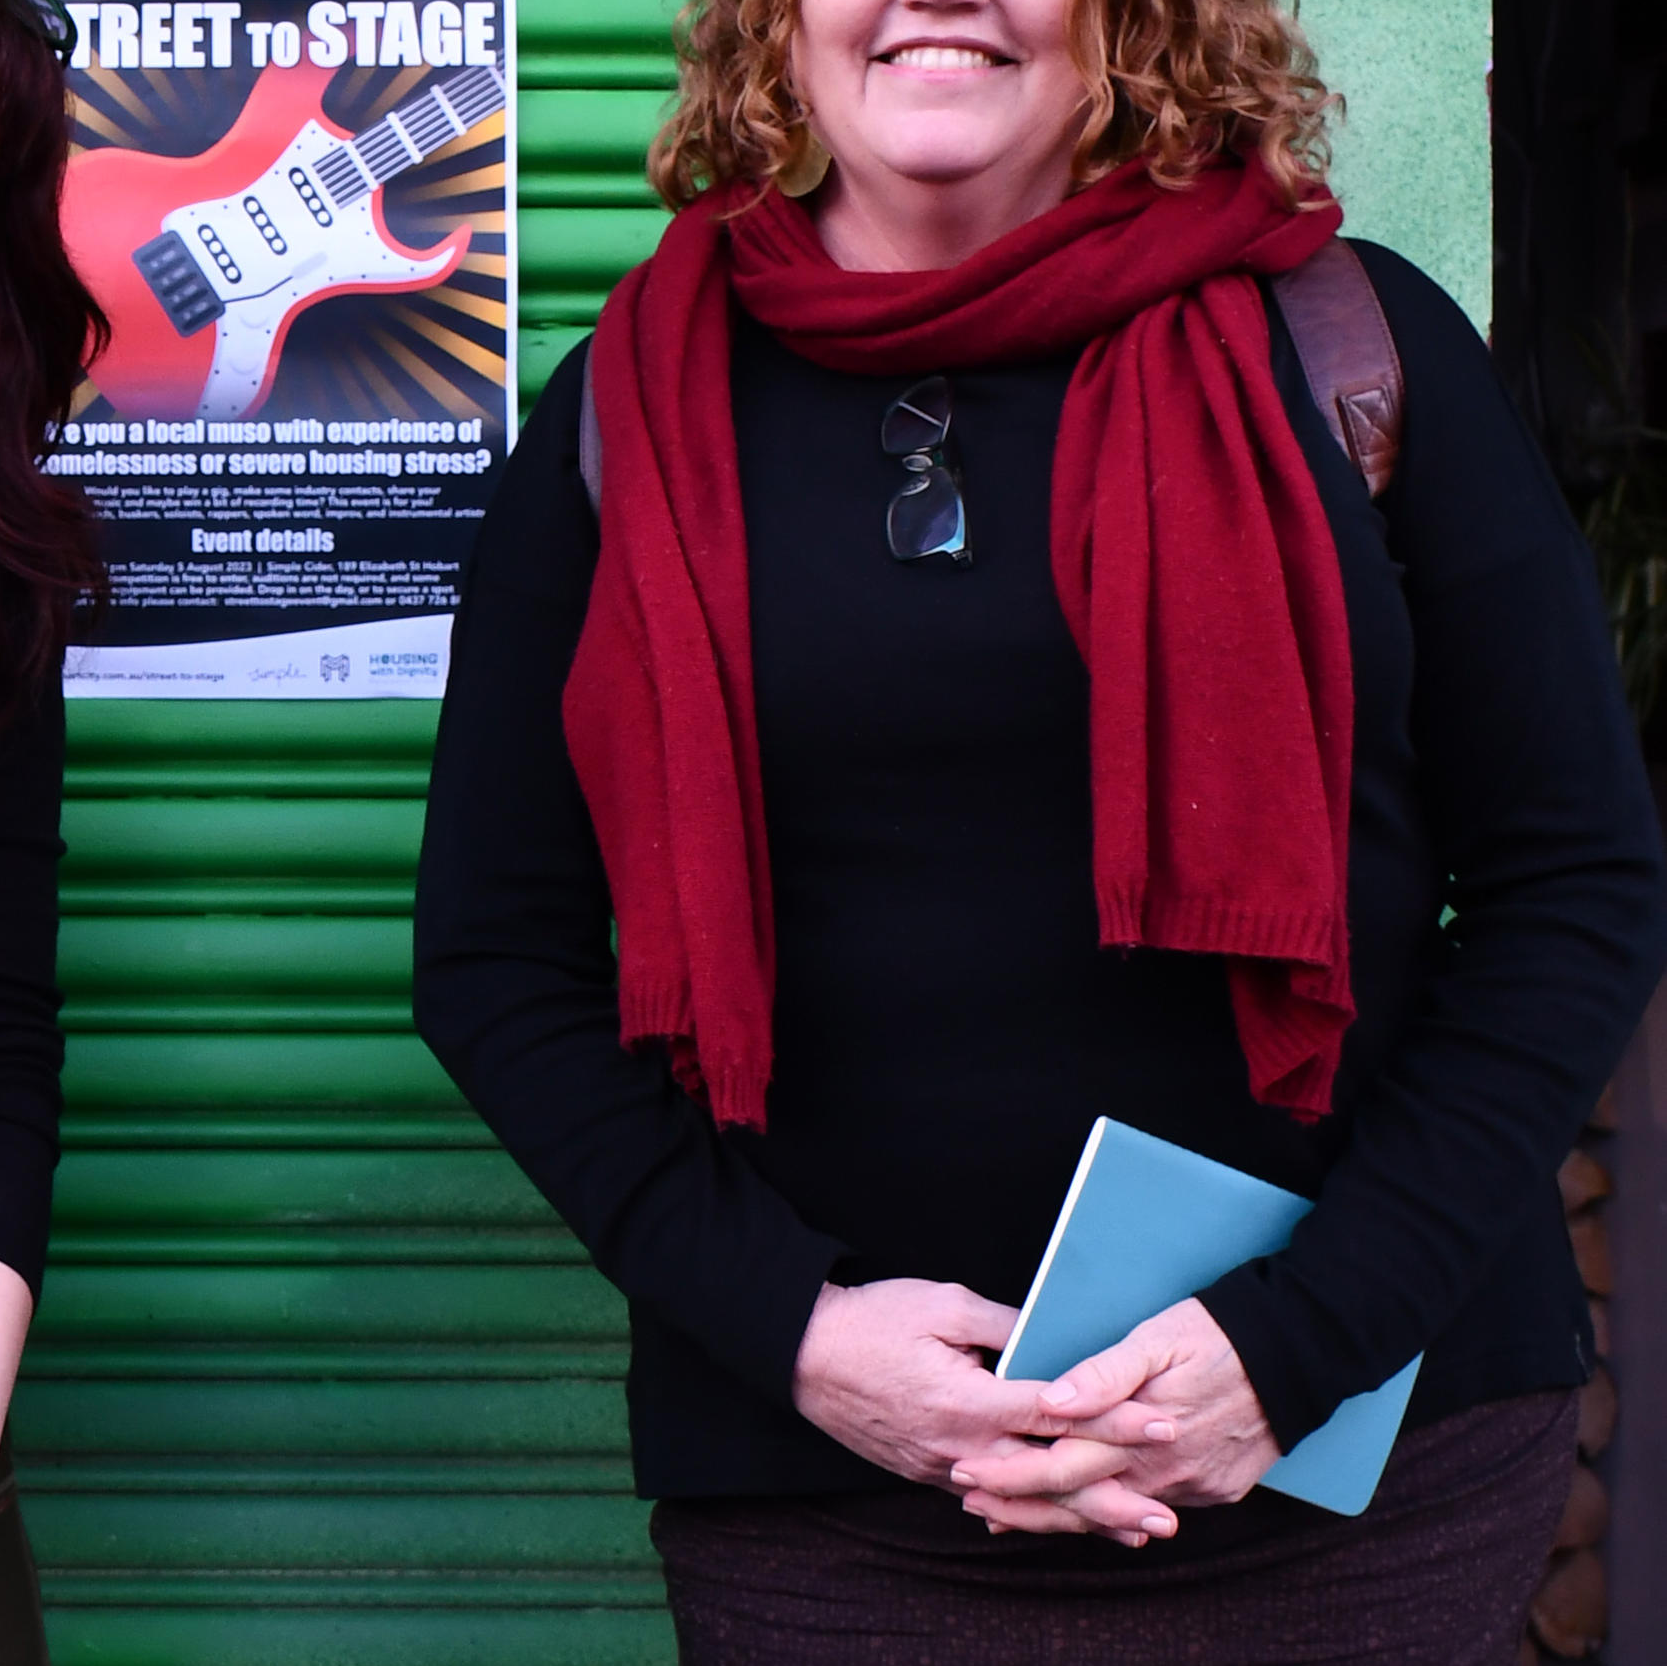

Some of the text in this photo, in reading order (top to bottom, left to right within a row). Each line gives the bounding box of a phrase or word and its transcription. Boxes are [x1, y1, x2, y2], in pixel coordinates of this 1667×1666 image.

[67, 0, 498, 69] TREET TO STAGE
[83, 421, 126, 447] you
[128, 422, 145, 444] a
[147, 419, 205, 444] local
[207, 421, 271, 444] muso
[273, 418, 324, 444] with
[327, 418, 455, 446] experience
[457, 418, 483, 444] of
[200, 452, 227, 475] or
[228, 452, 306, 475] severe
[309, 449, 402, 478] housing
[404, 448, 492, 475] stress?
[84, 485, 119, 496] Would
[121, 487, 141, 498] you
[142, 485, 161, 496] like
[163, 485, 175, 496] to
[177, 485, 200, 498] play
[233, 485, 262, 496] make
[264, 487, 292, 496] some
[294, 484, 336, 497] industry
[338, 484, 385, 497] contacts,
[387, 484, 416, 495] share
[417, 486, 442, 497] your
[124, 498, 144, 507] and
[146, 498, 181, 509] maybe
[183, 498, 202, 507] win
[212, 497, 227, 506] bit
[230, 497, 242, 506] of
[243, 497, 294, 508] recording
[295, 497, 326, 506] time?
[328, 497, 349, 506] This
[350, 497, 380, 506] event
[393, 497, 409, 506] for
[410, 497, 434, 508] you!
[118, 509, 162, 520] buskers,
[207, 510, 251, 520] rappers,
[253, 508, 291, 520] spoken
[365, 508, 386, 517] and
[388, 508, 453, 517] instrumental
[192, 528, 335, 553] Event details
[129, 561, 175, 574] Saturday
[186, 561, 224, 574] August
[226, 561, 252, 572] 2023
[266, 561, 302, 573] Simple
[303, 560, 335, 573] Cider,
[359, 560, 407, 571] Elizabeth
[409, 560, 421, 571] St
[422, 560, 460, 571] Hobart
[108, 574, 169, 585] competition
[182, 574, 203, 583] free
[205, 574, 217, 583] to
[252, 574, 300, 583] auditions
[301, 575, 319, 583] are
[320, 573, 339, 583] not
[340, 573, 388, 585] required,
[390, 573, 411, 583] and
[412, 575, 441, 583] some
[111, 586, 168, 597] equipment
[189, 586, 204, 595] be
[257, 586, 285, 597] Drop
[315, 585, 333, 594] the
[372, 585, 384, 594] to
[431, 585, 455, 596] spot
[142, 597, 175, 608] please
[369, 653, 439, 666] HOUSING
